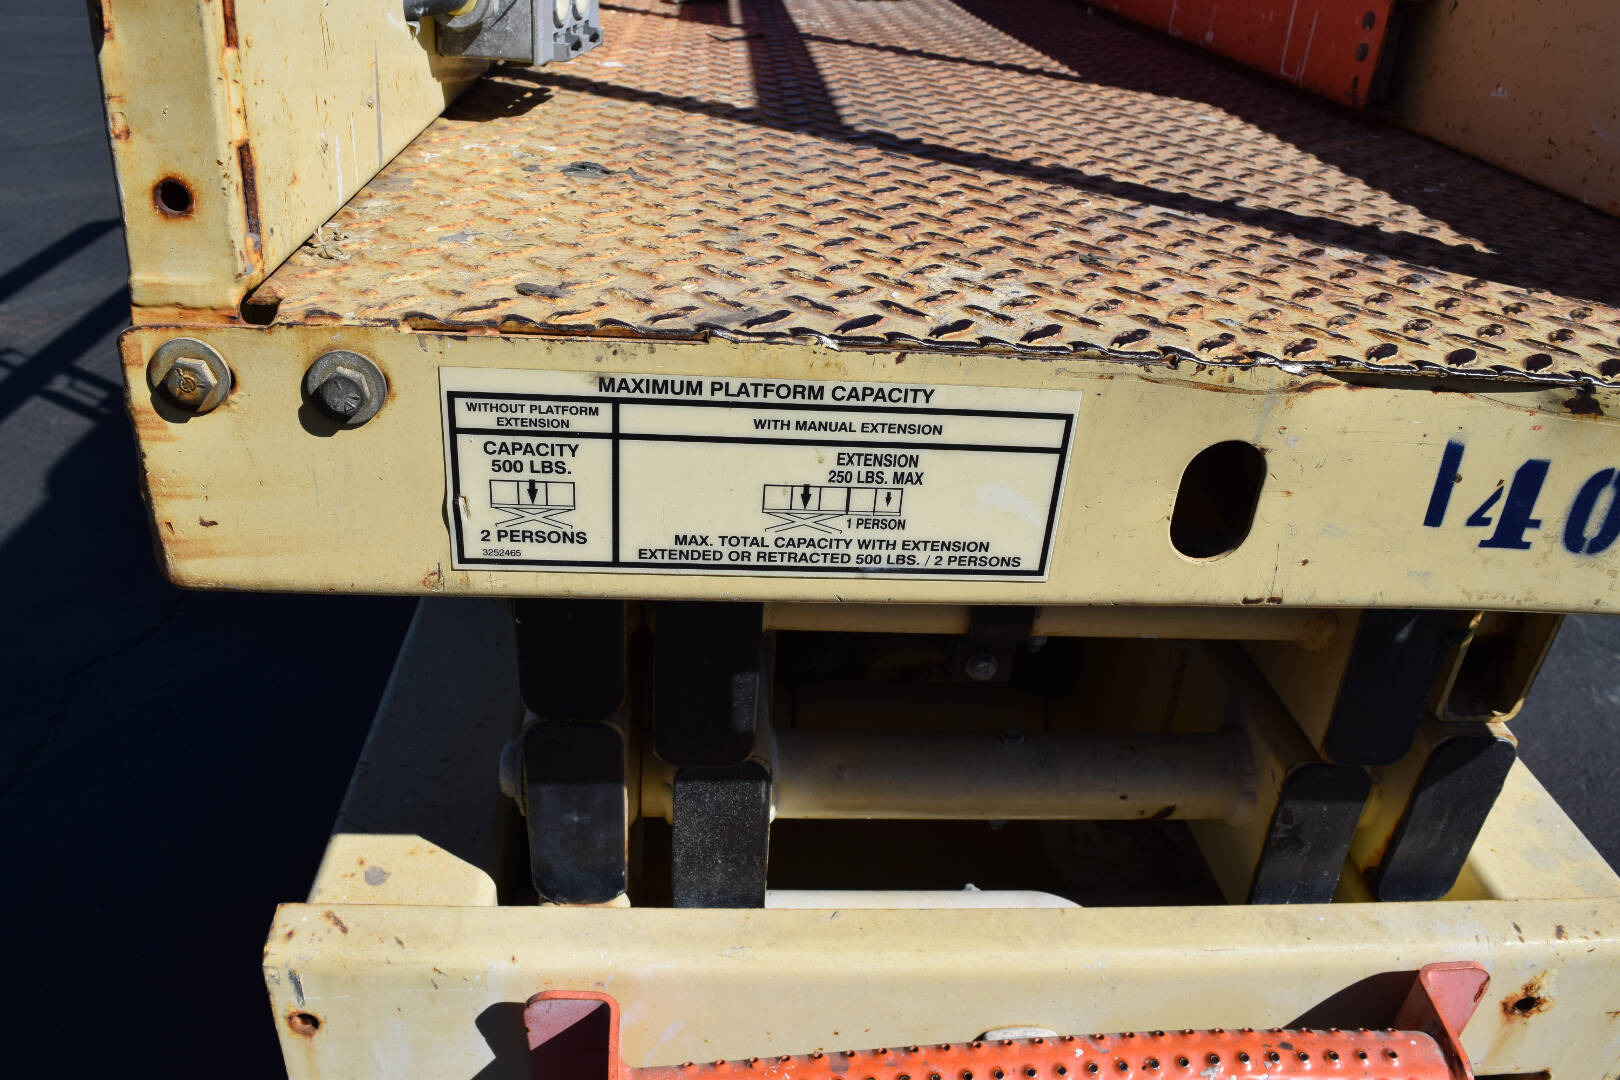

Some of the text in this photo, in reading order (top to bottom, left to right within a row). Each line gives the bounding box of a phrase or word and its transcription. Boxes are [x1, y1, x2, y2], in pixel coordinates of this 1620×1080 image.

[598, 377, 935, 404] MAXIMUM PLATFORM CAPACITY
[466, 401, 599, 416] WITHOUT PLATFORM
[496, 417, 570, 429] EXTENSION
[753, 419, 943, 435] WITH MANUAL EXTENSION
[483, 441, 580, 457] CAPACITY
[491, 460, 572, 475] 500 LBS.
[836, 453, 919, 468] EXTENSION
[828, 470, 924, 486] 250 LBS. MAX
[846, 518, 906, 530] 1 PERSON
[480, 529, 588, 545] 2 PERSONS
[674, 534, 990, 553] MAX. TOTAL CAPACITY WITH EXTENSION
[482, 548, 522, 557] 3252465
[638, 549, 1021, 568] EXTENDED OR RETRACTED 500 LBS. / 2 PERSONS
